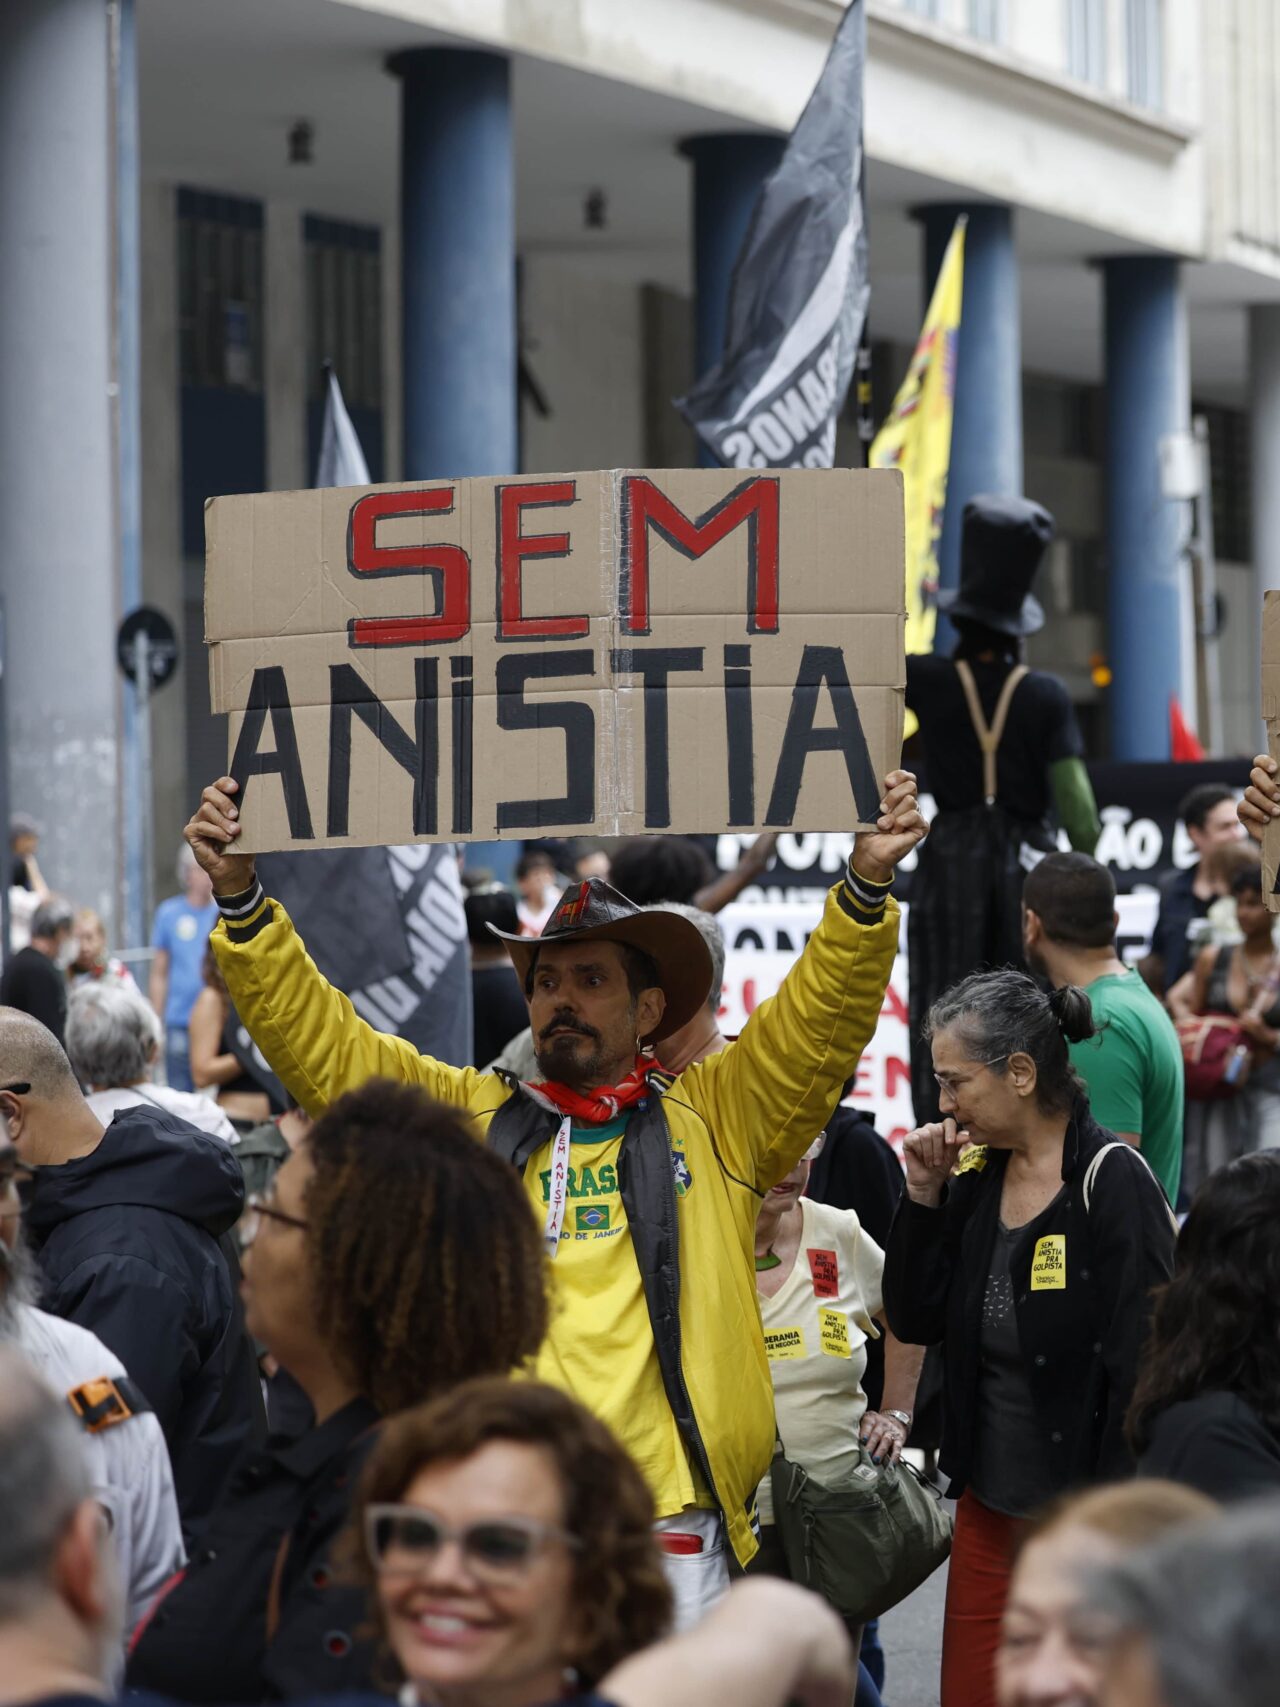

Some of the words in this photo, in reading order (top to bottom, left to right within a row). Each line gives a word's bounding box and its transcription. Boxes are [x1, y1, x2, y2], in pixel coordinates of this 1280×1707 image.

[346, 475, 780, 648] SEM
[230, 644, 882, 840] ANISTIA
[556, 1129, 567, 1154] SEM
[550, 1162, 565, 1230] ANISTIA
[575, 1231, 589, 1241] DE
[1041, 1241, 1054, 1249] SEM
[1046, 1255, 1059, 1263] PRA
[1033, 1262, 1063, 1272] GOLPISTA
[826, 1314, 838, 1322] SEM
[822, 1330, 848, 1342] GOLPISTA
[775, 1339, 801, 1349] NEGOCIA
